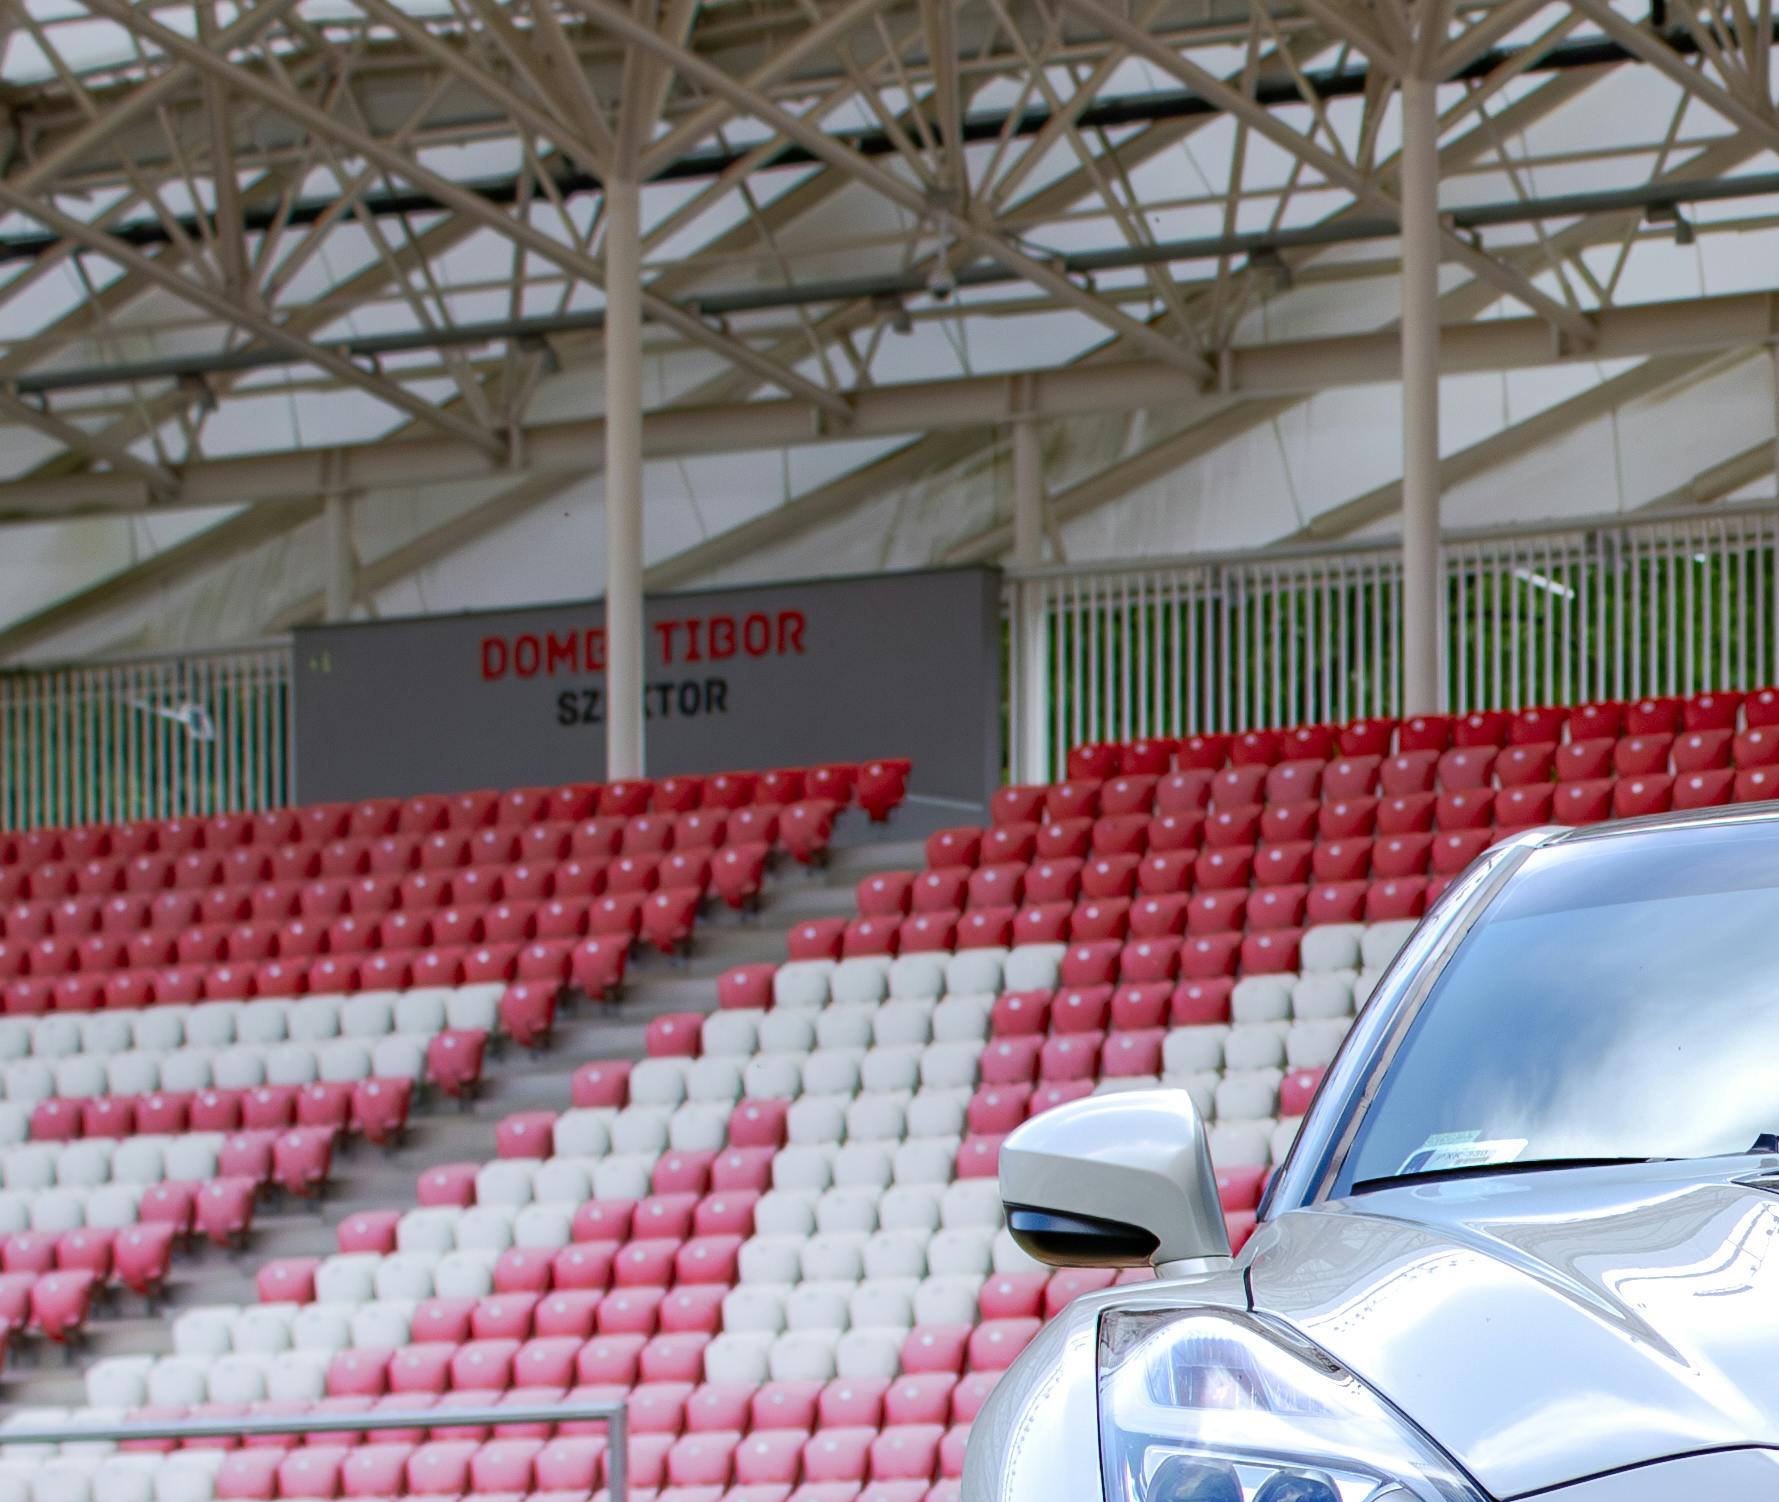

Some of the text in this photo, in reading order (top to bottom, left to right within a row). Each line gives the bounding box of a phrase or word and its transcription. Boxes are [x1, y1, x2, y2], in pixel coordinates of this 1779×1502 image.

[480, 610, 806, 682] DOMB TIBOR
[557, 678, 729, 726] SZTOR
